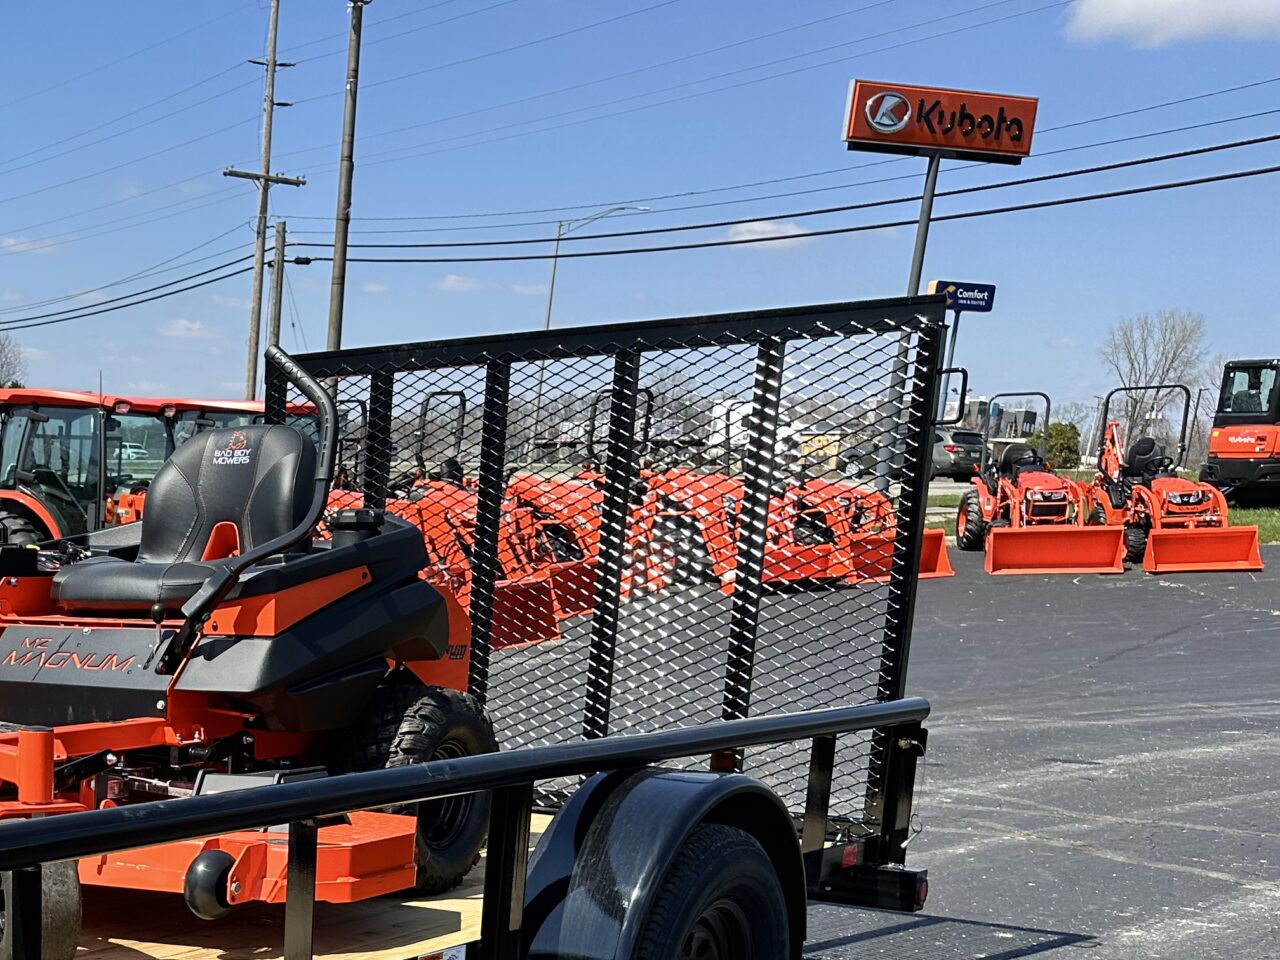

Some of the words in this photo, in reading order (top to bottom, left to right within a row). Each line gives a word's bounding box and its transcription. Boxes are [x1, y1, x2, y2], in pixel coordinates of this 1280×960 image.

[916, 98, 1023, 142] Kubota
[957, 288, 988, 300] Comfort
[1228, 435, 1255, 444] Kubota
[214, 449, 232, 457] BAD
[234, 448, 251, 457] BOY
[212, 456, 250, 465] MOWERS
[21, 637, 53, 649] MZ
[2, 650, 137, 672] MAGNUM
